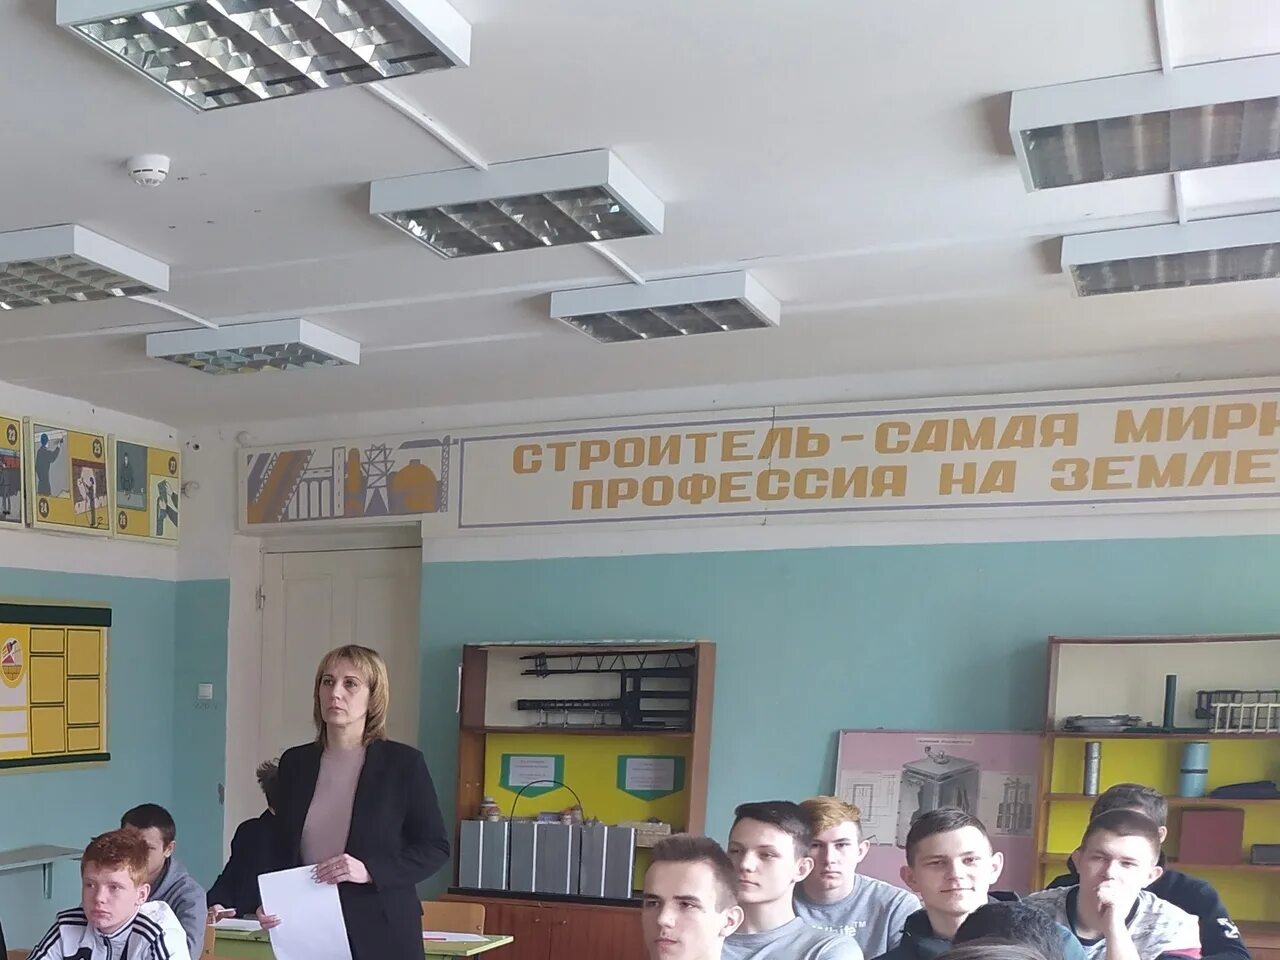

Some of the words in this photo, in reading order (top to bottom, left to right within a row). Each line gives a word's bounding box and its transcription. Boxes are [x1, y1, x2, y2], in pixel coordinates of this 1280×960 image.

[571, 465, 907, 511] ПРОФЕССИЯ
[938, 460, 1017, 495] НА
[1050, 449, 1278, 493] ЗЕМЛЕ
